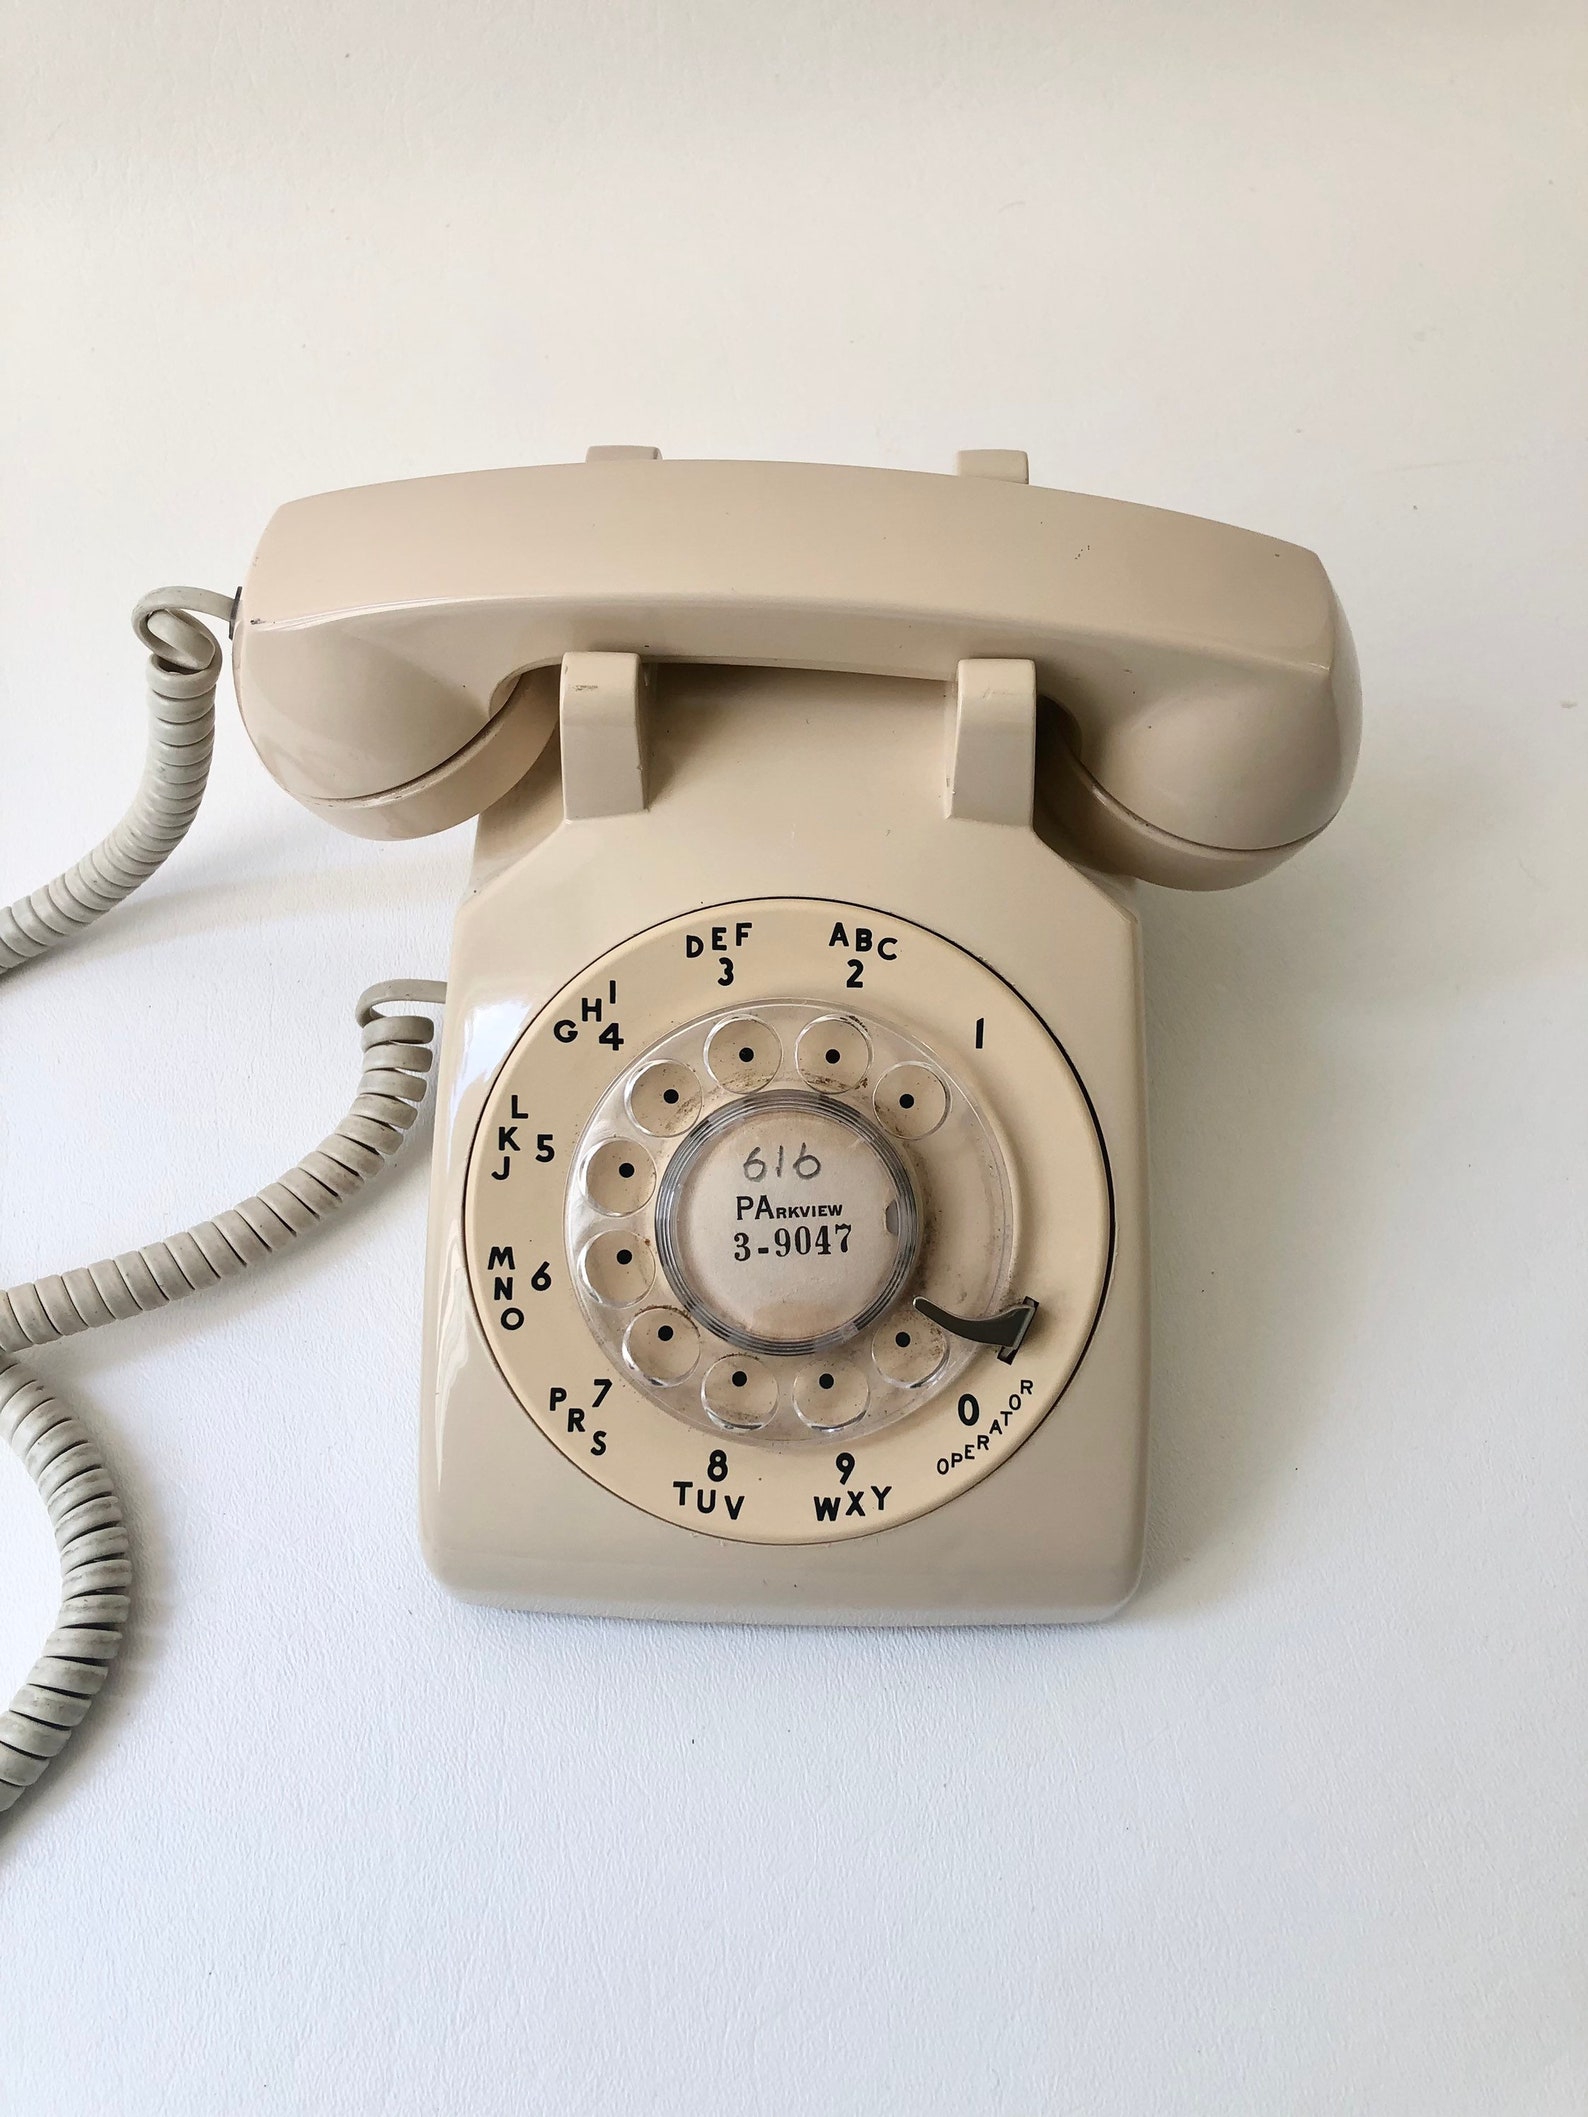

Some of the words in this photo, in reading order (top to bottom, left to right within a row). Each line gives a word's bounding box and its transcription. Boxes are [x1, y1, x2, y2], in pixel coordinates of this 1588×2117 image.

[685, 922, 753, 959] DEF
[828, 921, 898, 961] ABC
[717, 956, 735, 987] 3
[846, 958, 864, 989] 2
[553, 979, 617, 1044] GHI
[598, 1022, 625, 1052] 4
[535, 1133, 555, 1163] 5
[742, 1142, 822, 1183] 616
[733, 1222, 852, 1262] 3-9047
[530, 1260, 552, 1292] 6
[591, 1378, 613, 1408] 7
[549, 1387, 607, 1456] PRS
[936, 1379, 1034, 1476] OPERATOR
[706, 1449, 729, 1483] 8
[835, 1451, 856, 1486] 9
[672, 1480, 745, 1521] TUV
[813, 1485, 893, 1522] WXY
